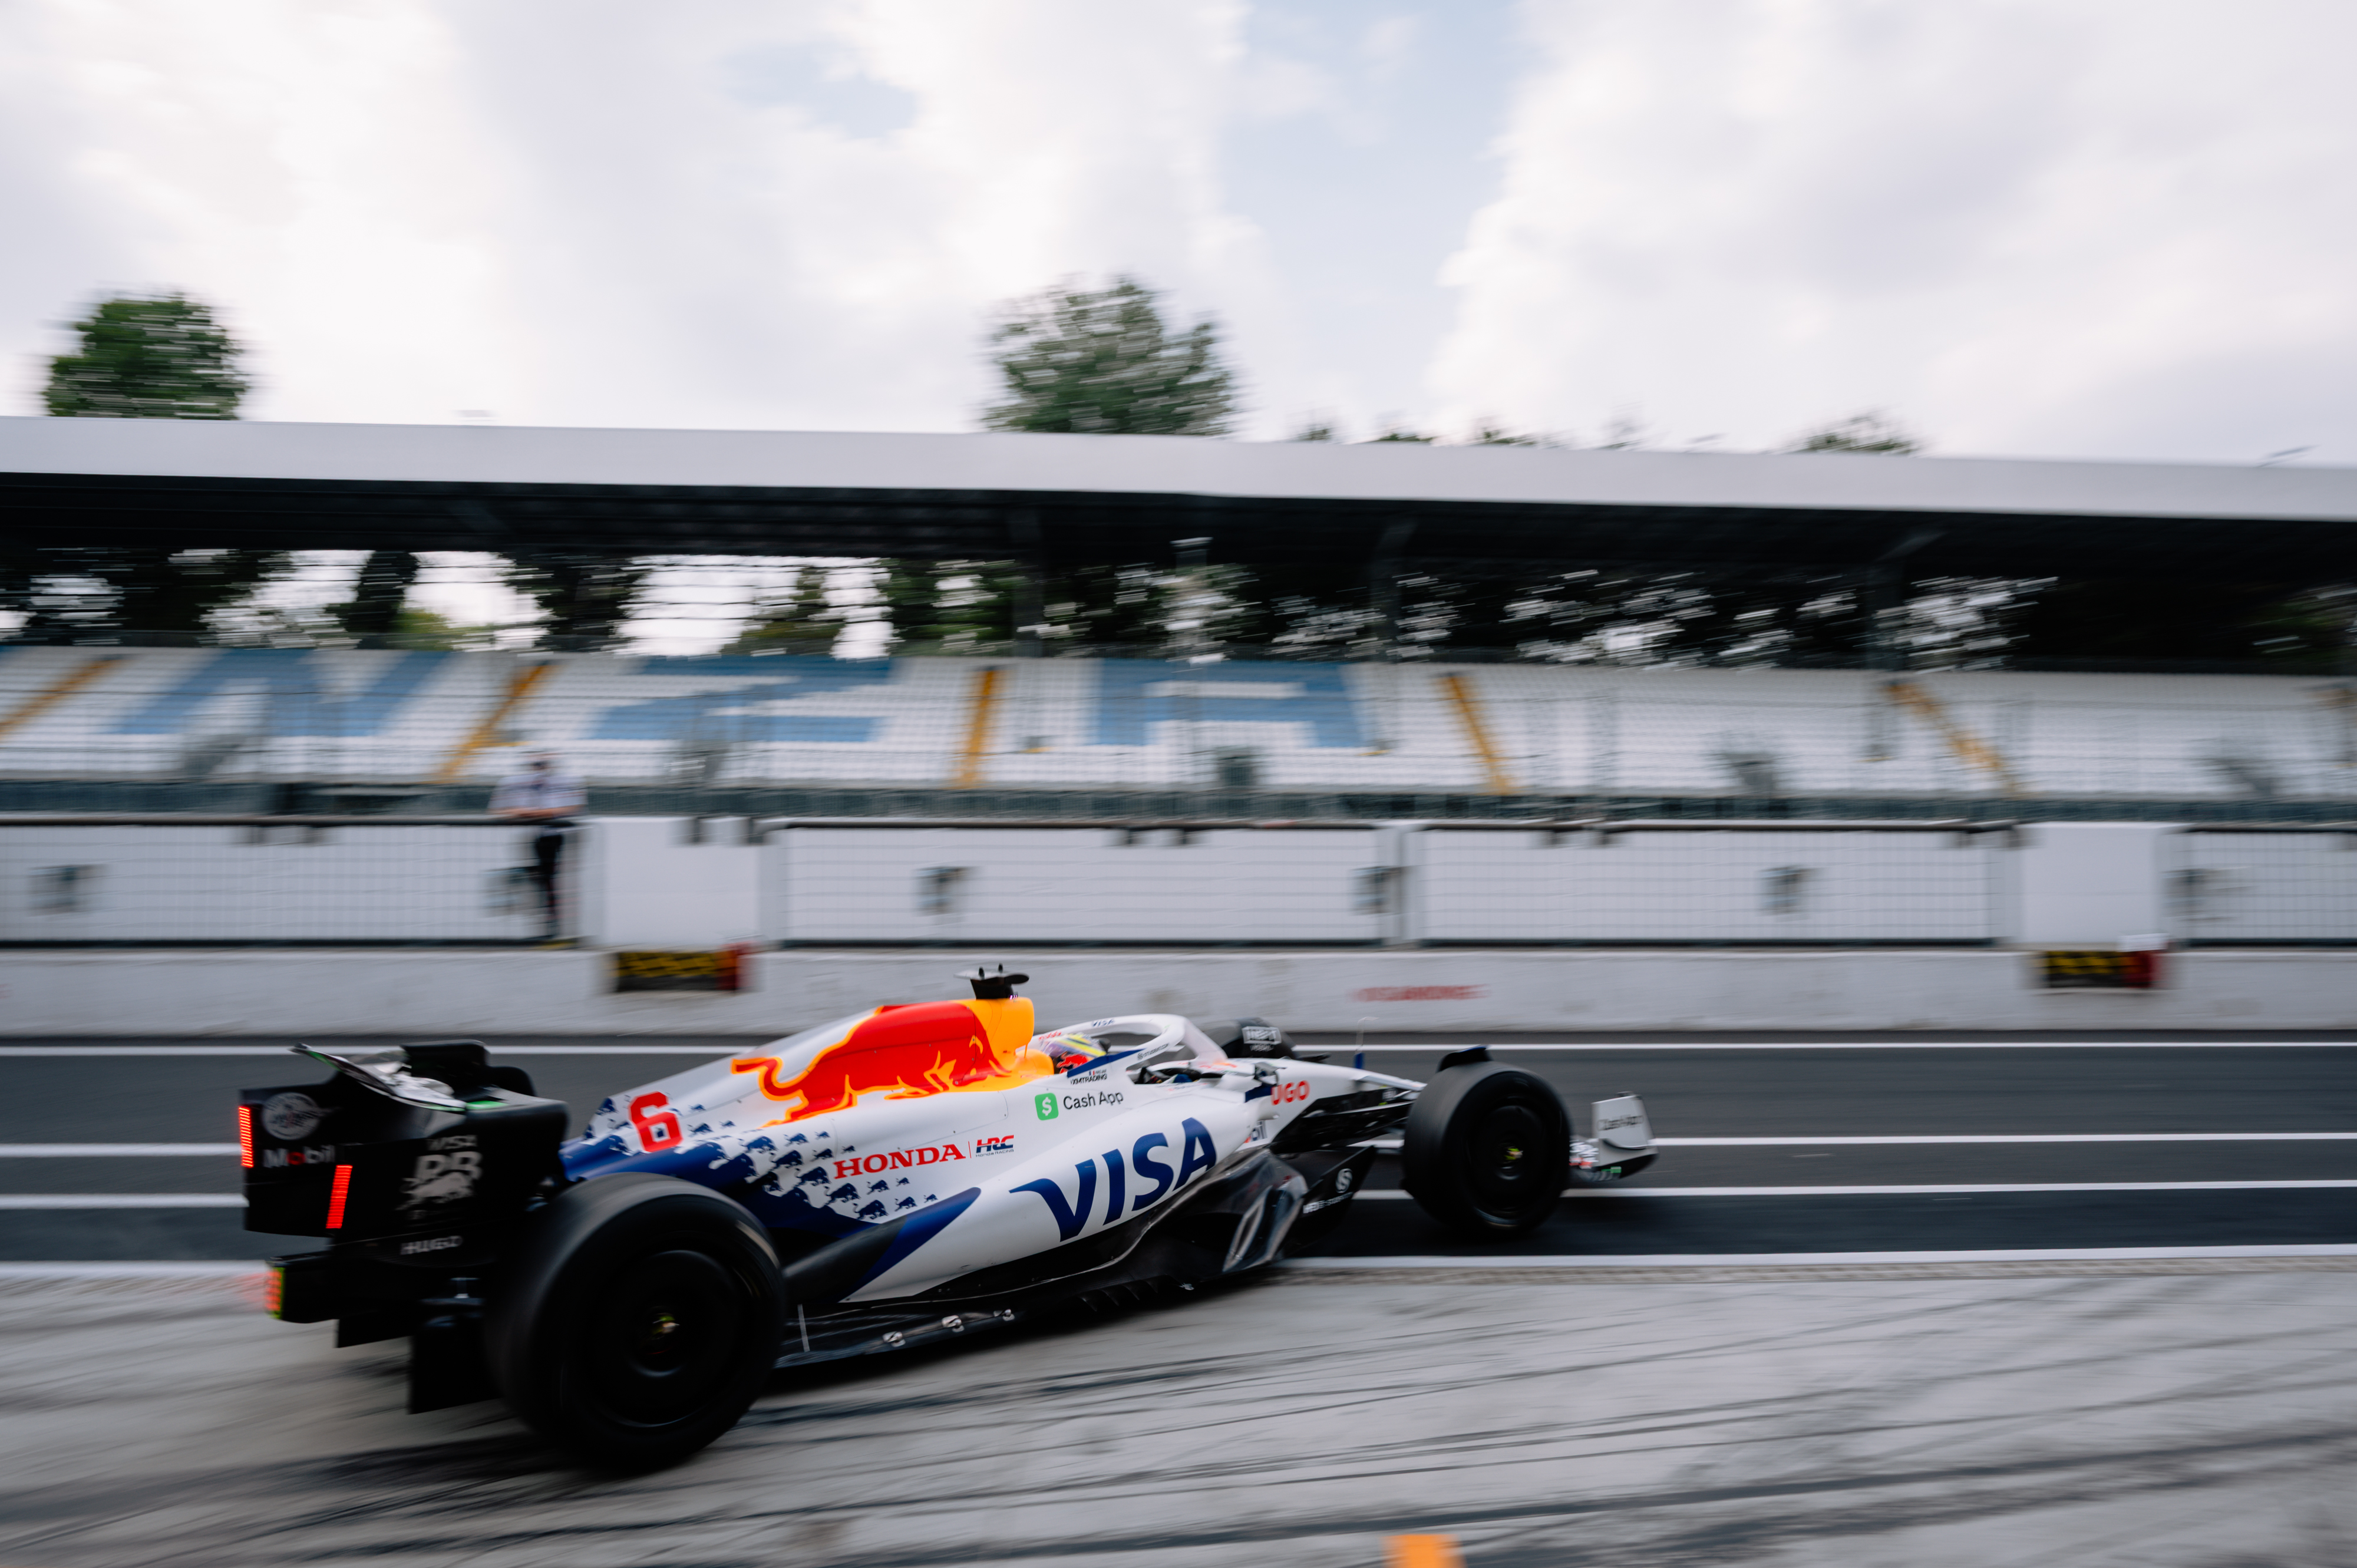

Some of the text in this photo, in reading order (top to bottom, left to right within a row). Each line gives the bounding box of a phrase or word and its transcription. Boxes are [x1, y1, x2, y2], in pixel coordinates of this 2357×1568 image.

[1063, 1093, 1096, 1110] Cash
[1099, 1091, 1124, 1106] App
[1270, 1080, 1310, 1106] UGO
[628, 1091, 684, 1153] 6
[263, 1145, 335, 1168] Mobil
[976, 1134, 1014, 1154] HRC
[833, 1143, 966, 1180] HONDA
[1008, 1117, 1217, 1243] VISA
